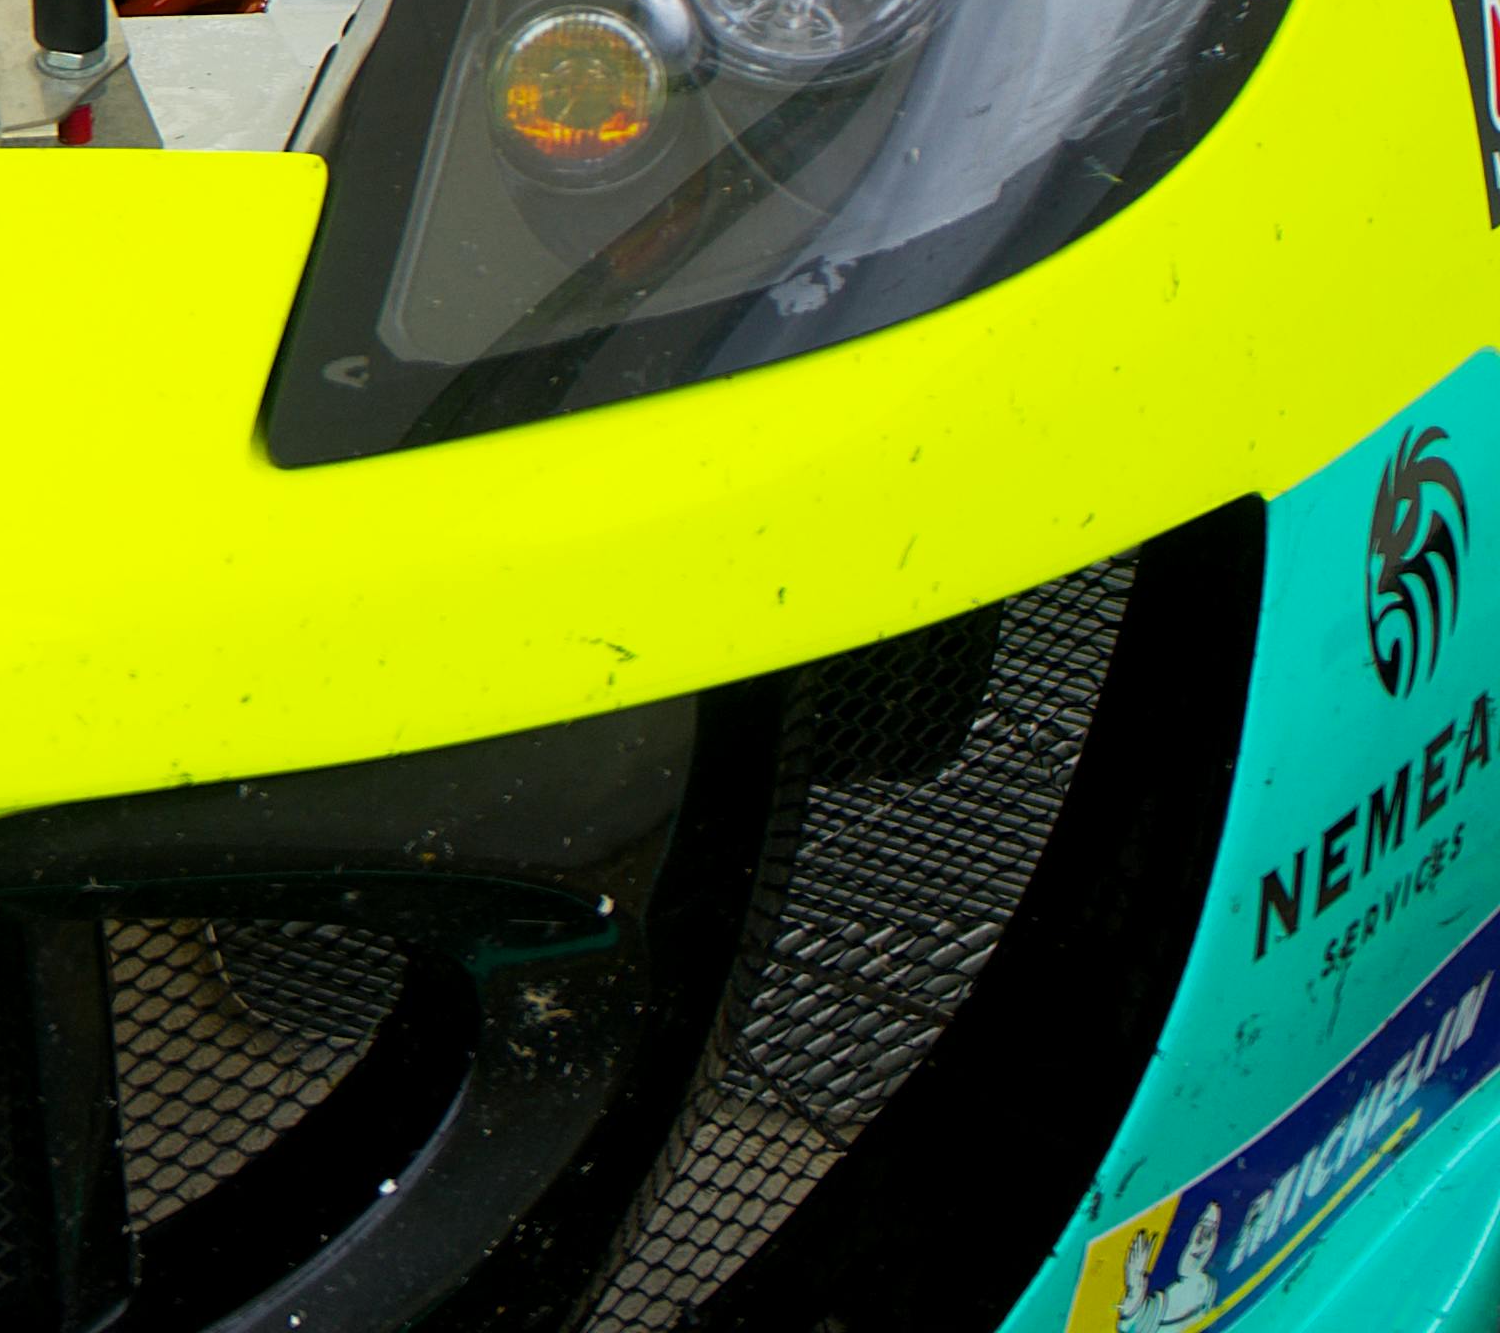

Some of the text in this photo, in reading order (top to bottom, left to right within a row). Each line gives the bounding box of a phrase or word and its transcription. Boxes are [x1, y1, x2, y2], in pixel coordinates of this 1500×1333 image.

[1252, 690, 1500, 965] NEMEA
[1320, 822, 1466, 979] SERVICES
[1227, 969, 1495, 1274] MICHELIN
